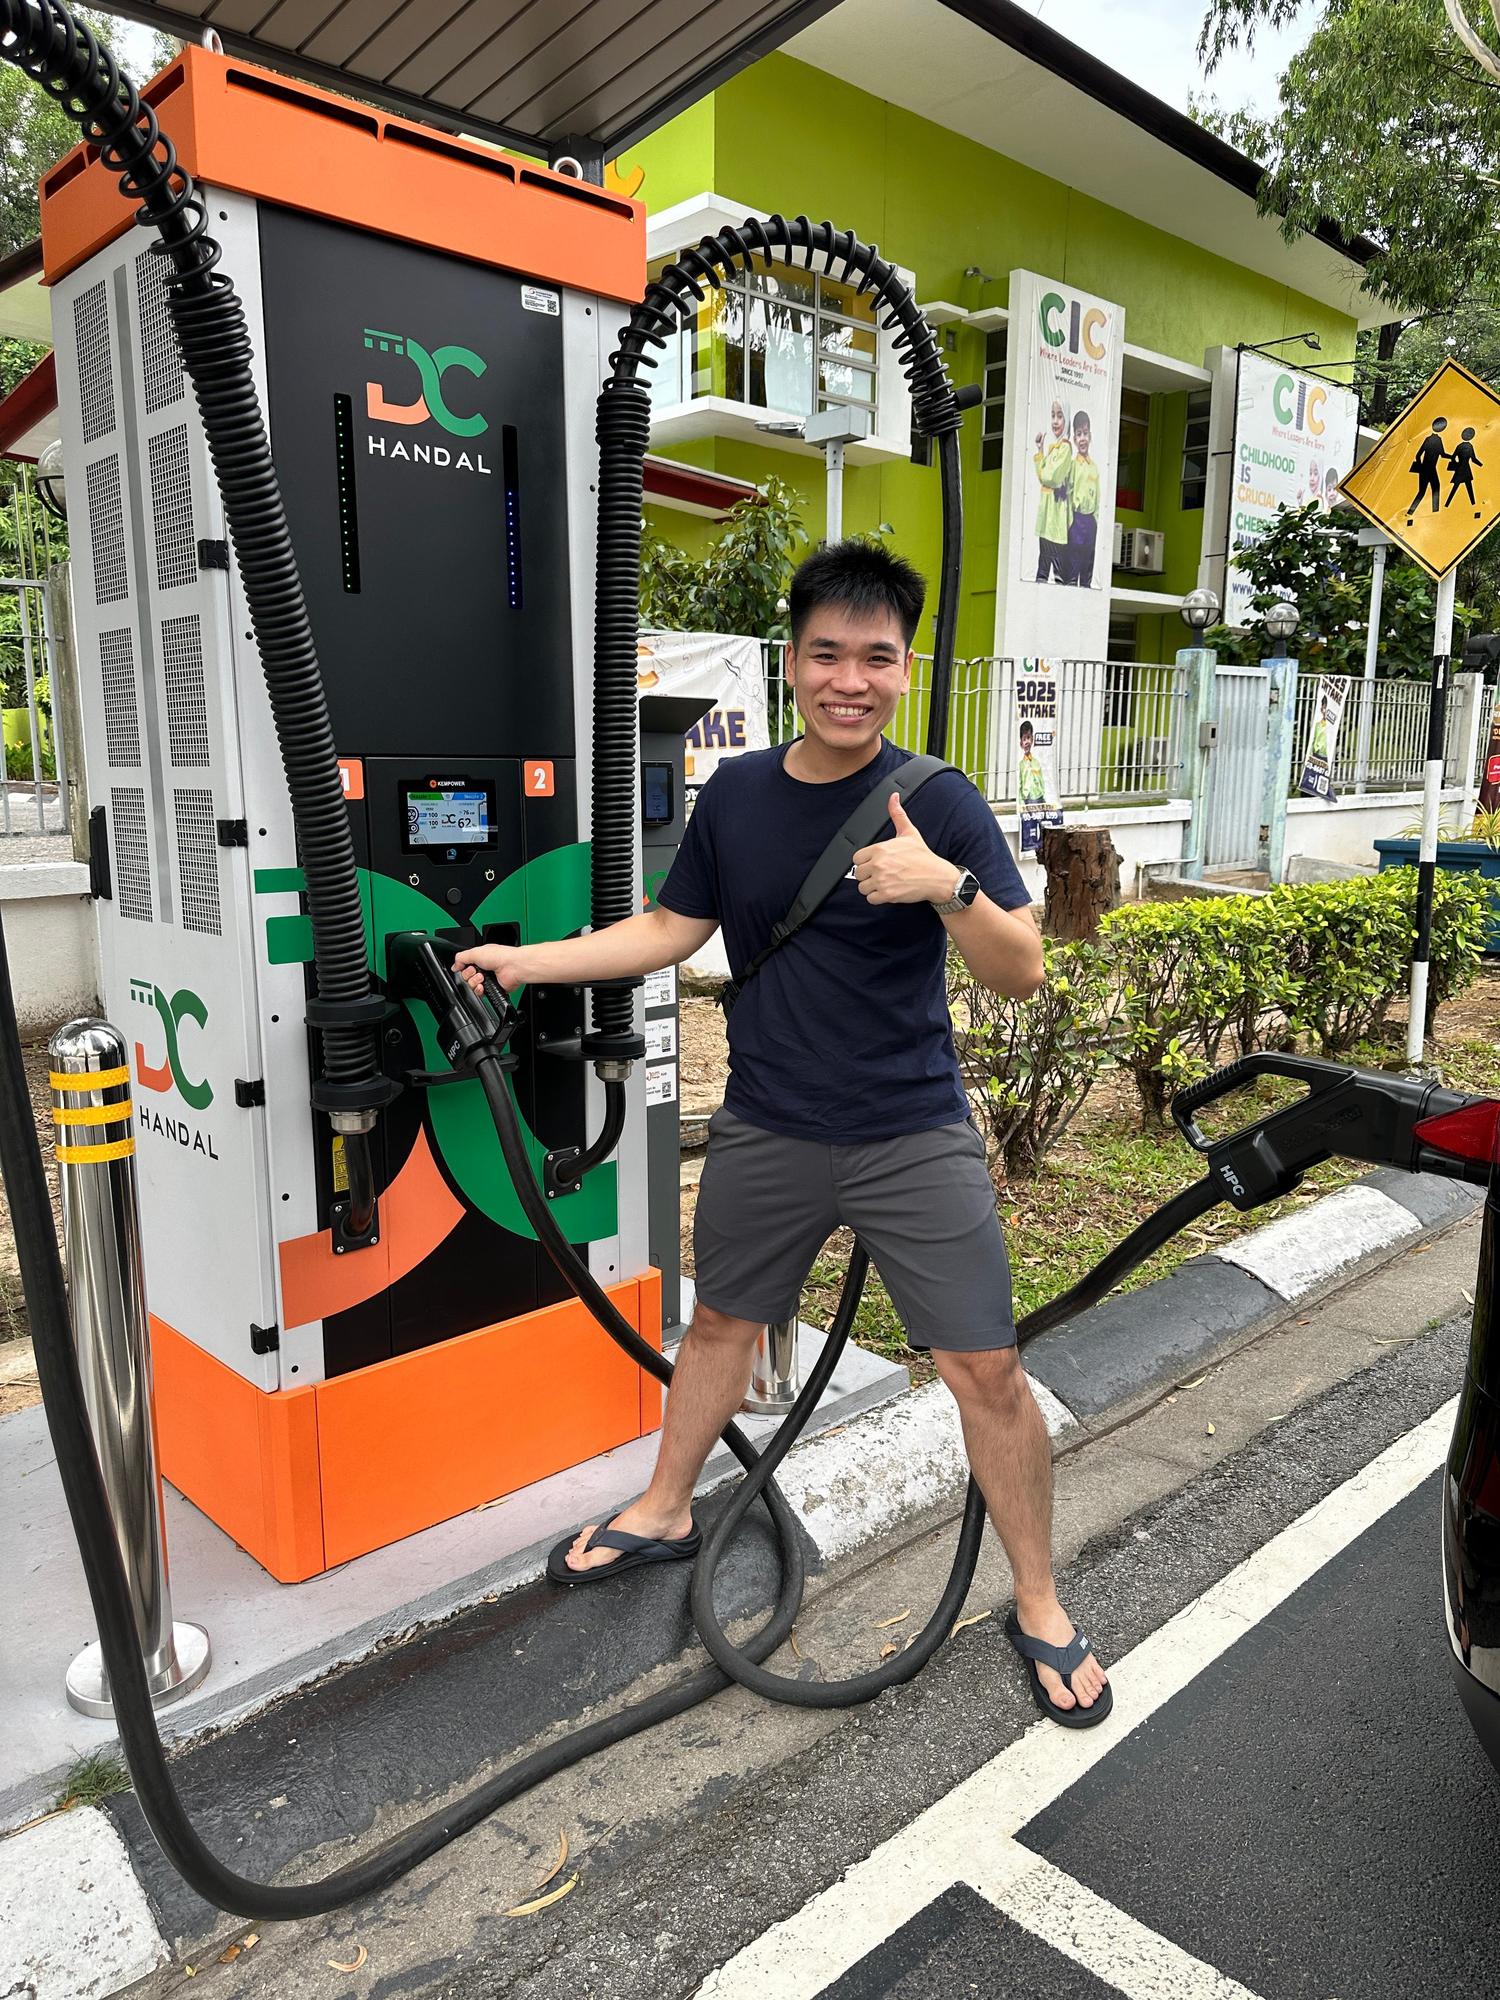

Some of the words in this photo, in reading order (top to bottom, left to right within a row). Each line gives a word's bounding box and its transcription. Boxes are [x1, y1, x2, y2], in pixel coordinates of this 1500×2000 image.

[1039, 293, 1107, 360] CIC
[1273, 373, 1327, 436] CIC
[368, 436, 491, 474] HANDAL
[1240, 444, 1295, 474] CHILDHOOD
[1240, 464, 1251, 483] IS
[1237, 484, 1277, 509] CRUCIAL
[1017, 681, 1056, 702] 2025
[685, 711, 746, 747] AKE
[534, 768, 546, 789] 2
[458, 818, 472, 828] 62
[448, 1040, 460, 1060] HPC
[139, 1105, 218, 1160] HANDAL
[1220, 1164, 1245, 1196] HPC
